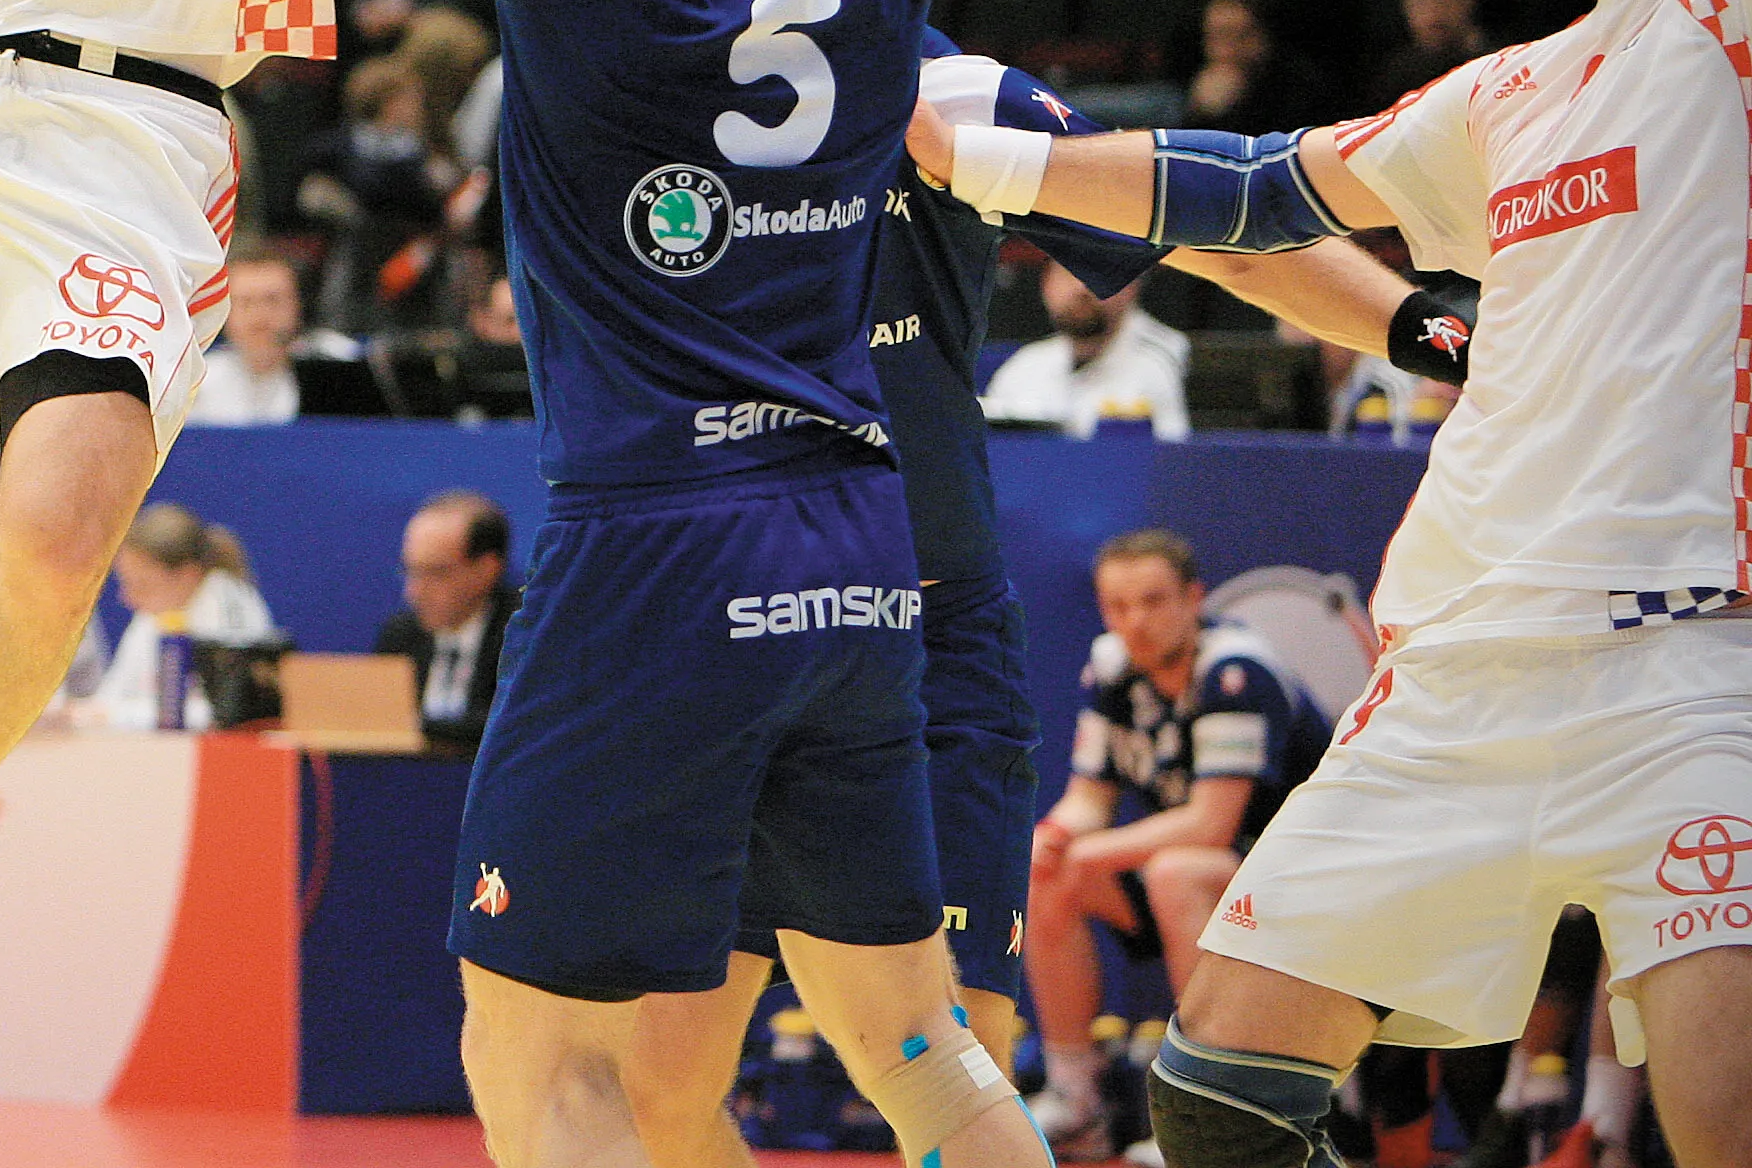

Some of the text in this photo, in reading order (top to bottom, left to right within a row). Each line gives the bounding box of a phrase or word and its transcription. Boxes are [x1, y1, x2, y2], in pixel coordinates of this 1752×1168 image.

[638, 172, 724, 212] SKODA
[649, 247, 705, 267] AUTO
[39, 321, 154, 378] TOYOTA
[867, 314, 921, 348] AIR
[1221, 911, 1257, 930] adidas
[1653, 901, 1752, 948] TOYO
